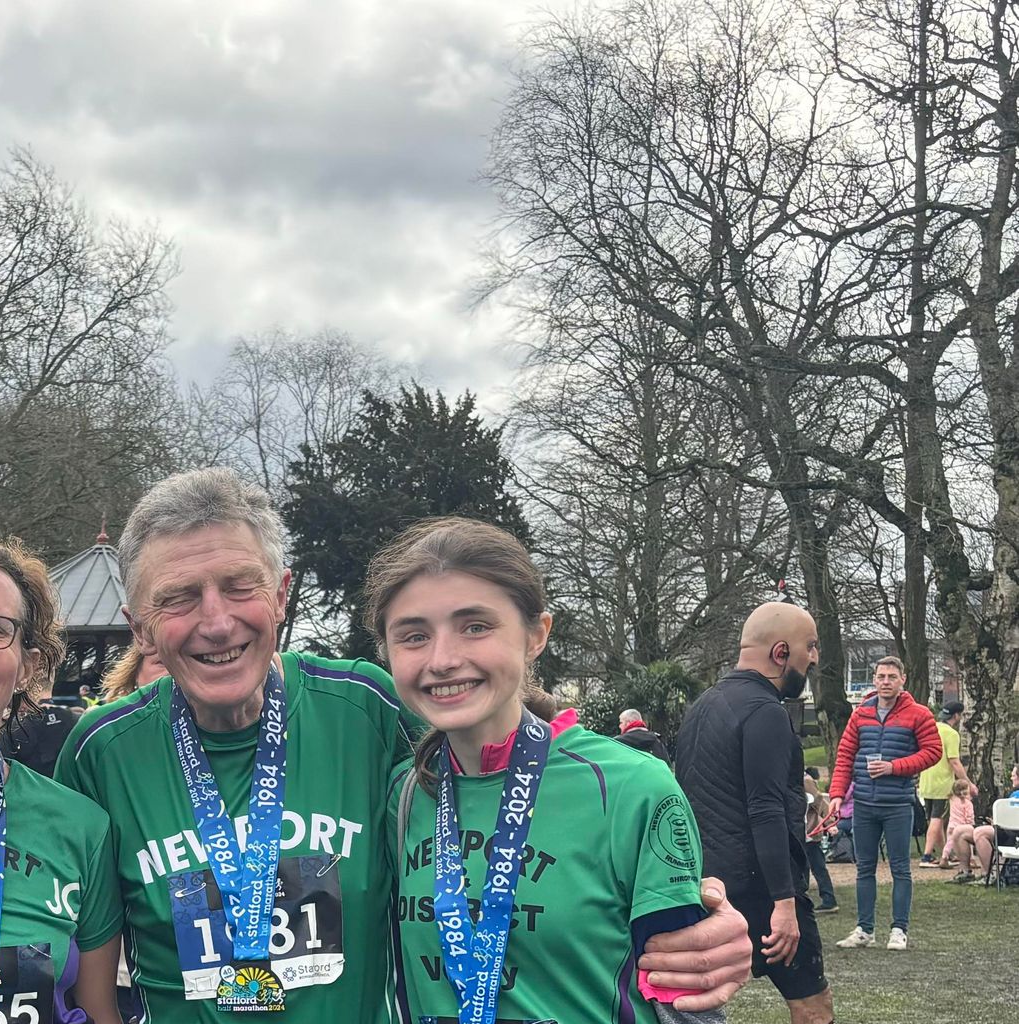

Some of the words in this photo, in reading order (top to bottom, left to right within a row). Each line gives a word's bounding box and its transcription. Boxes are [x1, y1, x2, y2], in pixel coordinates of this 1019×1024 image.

[266, 697, 282, 746] 2024
[189, 788, 202, 808] 2024
[257, 764, 279, 807] 1984
[209, 830, 238, 875] 1984
[268, 840, 278, 861] 2024
[491, 847, 517, 894] 1984
[505, 772, 534, 826] 2024
[247, 879, 263, 937] stafford
[264, 864, 276, 914] marathon
[193, 902, 323, 964] 181
[441, 909, 468, 957] 1984
[487, 956, 502, 1008] marathon
[495, 930, 507, 953] 2024
[217, 995, 258, 1005] stafford
